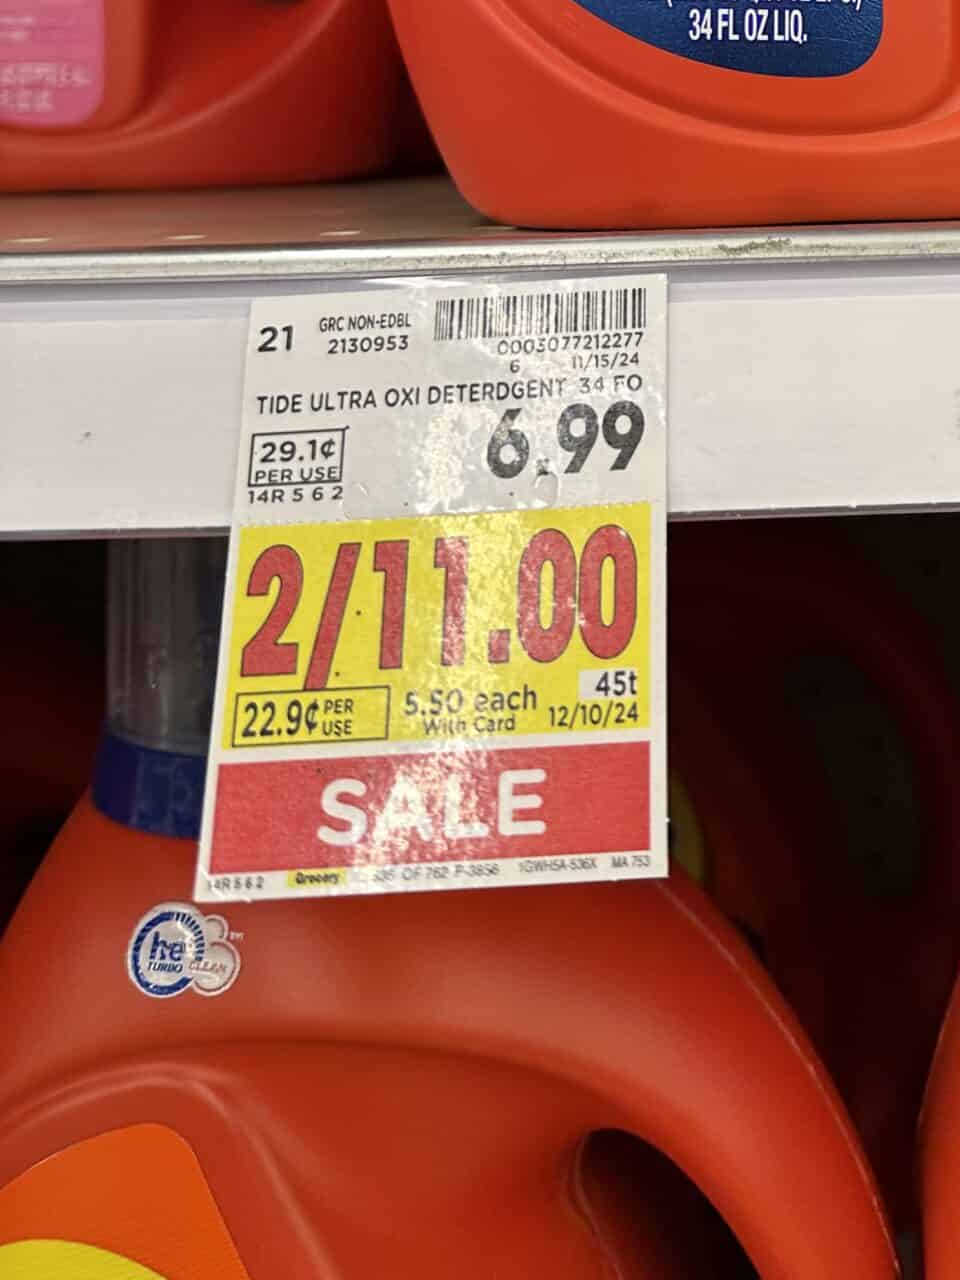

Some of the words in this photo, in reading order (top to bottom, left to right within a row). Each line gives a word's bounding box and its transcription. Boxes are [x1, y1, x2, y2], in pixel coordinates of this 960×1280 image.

[689, 8, 712, 41] 34
[718, 8, 739, 41] FL
[745, 9, 768, 41] OZ
[774, 10, 807, 44] LIQ.
[319, 316, 345, 332] GRC
[347, 313, 412, 332] NON-EDBL
[257, 325, 293, 352] 21
[327, 335, 409, 355] 2130953
[510, 360, 521, 373] 6
[571, 352, 640, 370] 11/15/24
[256, 394, 303, 414] TIDE
[310, 389, 377, 412] ULTRA
[384, 386, 420, 408] OXI
[427, 378, 567, 405] DETERDGENT
[578, 376, 604, 394] 34
[613, 374, 643, 393] FO
[259, 438, 336, 464] 29.1¢
[487, 400, 645, 479] 6.99
[255, 469, 293, 485] PER
[300, 466, 338, 482] USE
[248, 489, 284, 505] 14R
[293, 489, 303, 503] 5
[313, 487, 323, 502] 6
[332, 486, 343, 500] 2
[240, 524, 637, 690] 2/11.00
[595, 671, 638, 696] 45t
[404, 689, 464, 716] 5.50
[474, 683, 538, 711] each
[241, 698, 319, 738] 22.9¢
[324, 698, 354, 715] PER
[424, 718, 467, 735] With
[474, 715, 516, 733] Card
[549, 700, 639, 730] 12/10/24
[322, 720, 352, 736] USE
[317, 768, 548, 847] SALE
[257, 876, 265, 888] 2
[295, 872, 339, 885] Grocery
[401, 868, 420, 880] OF
[150, 931, 185, 962] he
[147, 961, 183, 973] TURBO
